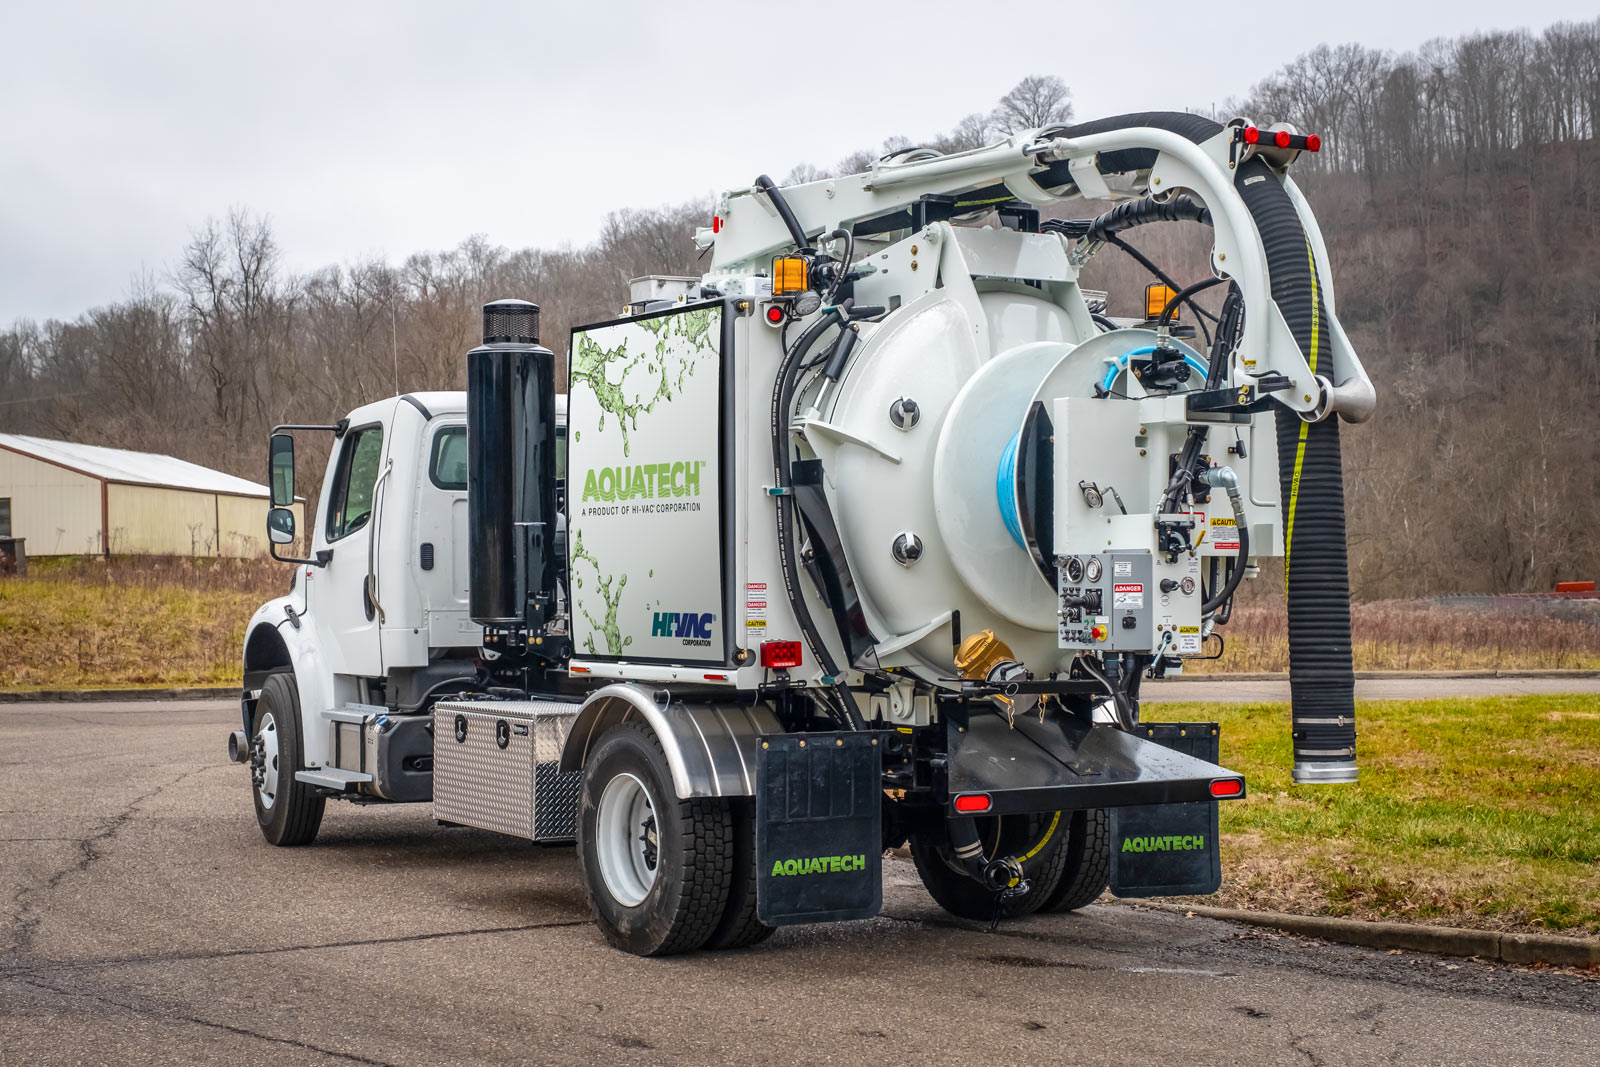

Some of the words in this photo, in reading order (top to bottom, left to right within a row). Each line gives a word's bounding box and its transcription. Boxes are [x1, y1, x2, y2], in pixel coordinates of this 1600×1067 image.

[582, 461, 700, 503] AQUATECH
[581, 508, 586, 516] A
[588, 506, 619, 516] PRODUCT
[621, 505, 630, 515] OF
[656, 502, 701, 513] CORPORATION
[682, 639, 711, 647] CORPORATION
[1121, 835, 1204, 853] AQUATECH
[771, 854, 866, 877] AQUATECH
